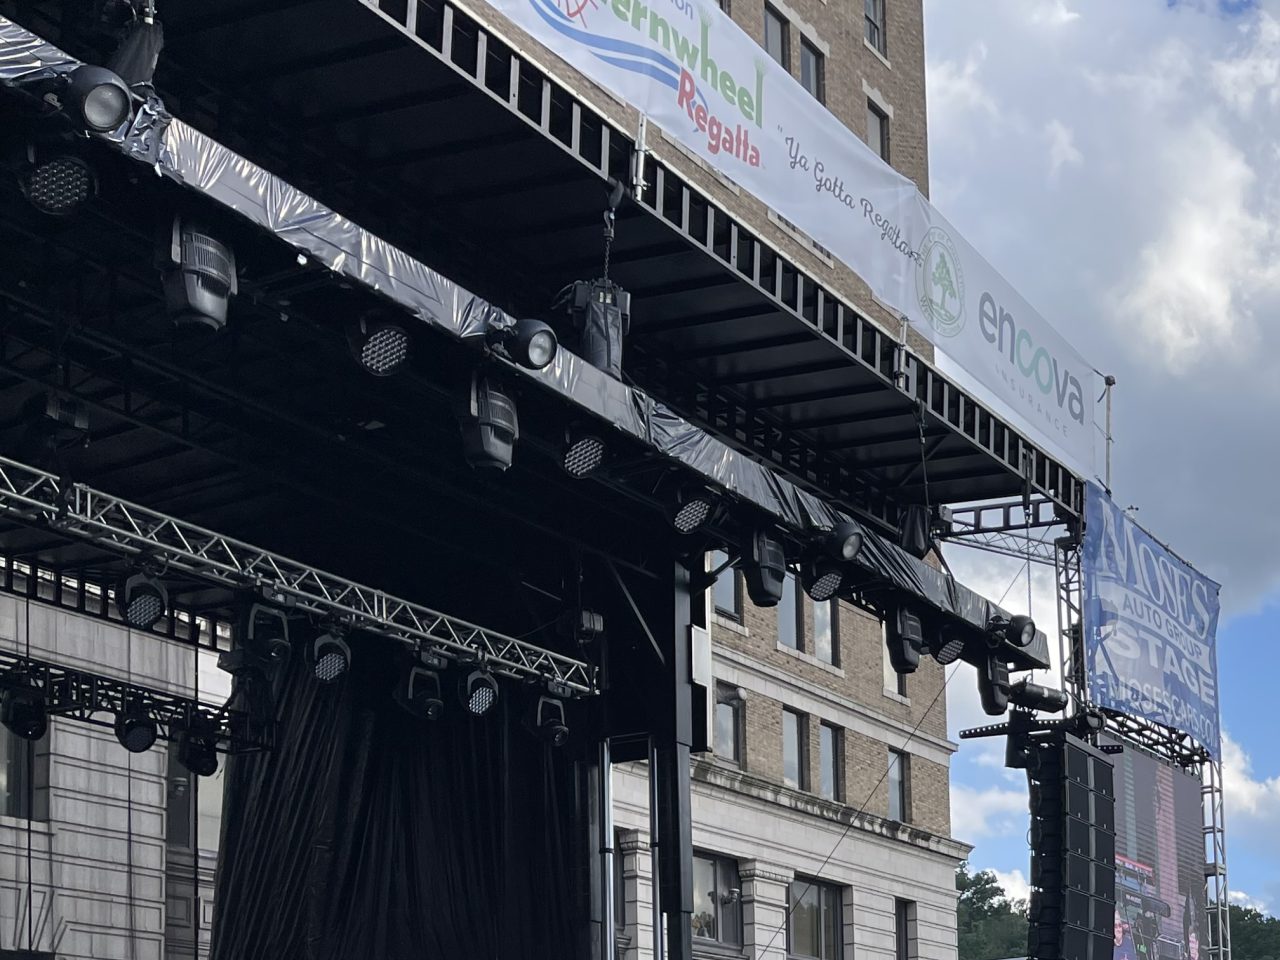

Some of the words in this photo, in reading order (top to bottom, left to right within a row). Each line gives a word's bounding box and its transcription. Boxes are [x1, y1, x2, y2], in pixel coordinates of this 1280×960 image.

[603, 0, 765, 128] ernwheel
[677, 67, 761, 168] Regatta
[814, 159, 855, 209] Gotta
[978, 291, 1085, 426] encova
[994, 364, 1069, 438] INSURANCE
[1098, 496, 1211, 640] MOSES
[1107, 623, 1215, 708] STAGE
[1122, 592, 1162, 630] AUTO
[1165, 620, 1203, 661] GROUP
